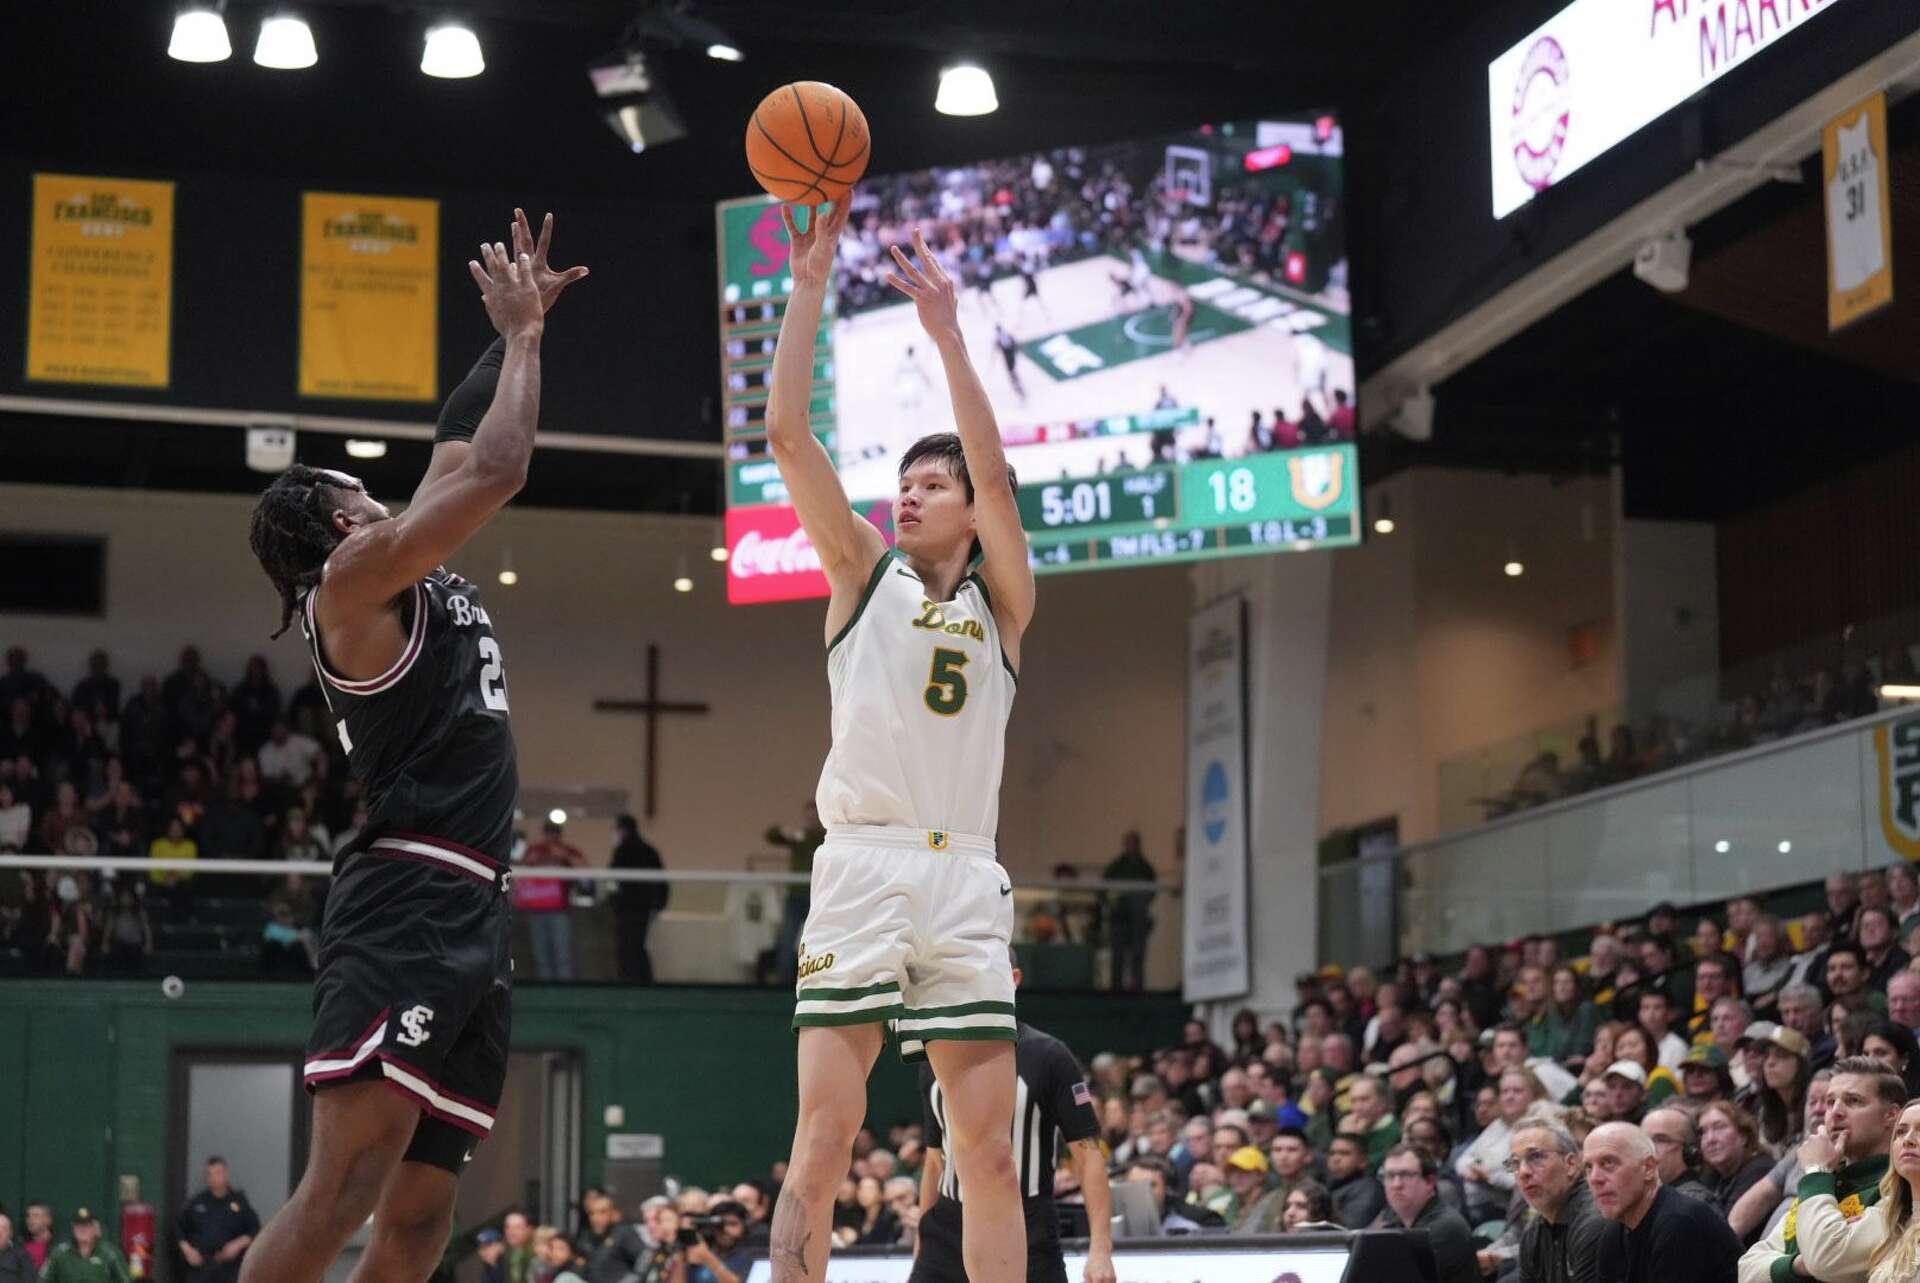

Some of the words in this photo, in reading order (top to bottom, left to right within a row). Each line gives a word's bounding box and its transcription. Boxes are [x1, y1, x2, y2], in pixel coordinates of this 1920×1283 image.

[1846, 180, 1865, 221] 31
[1041, 481, 1111, 526] 5:01
[1208, 467, 1256, 515] 18
[924, 645, 970, 717] 5
